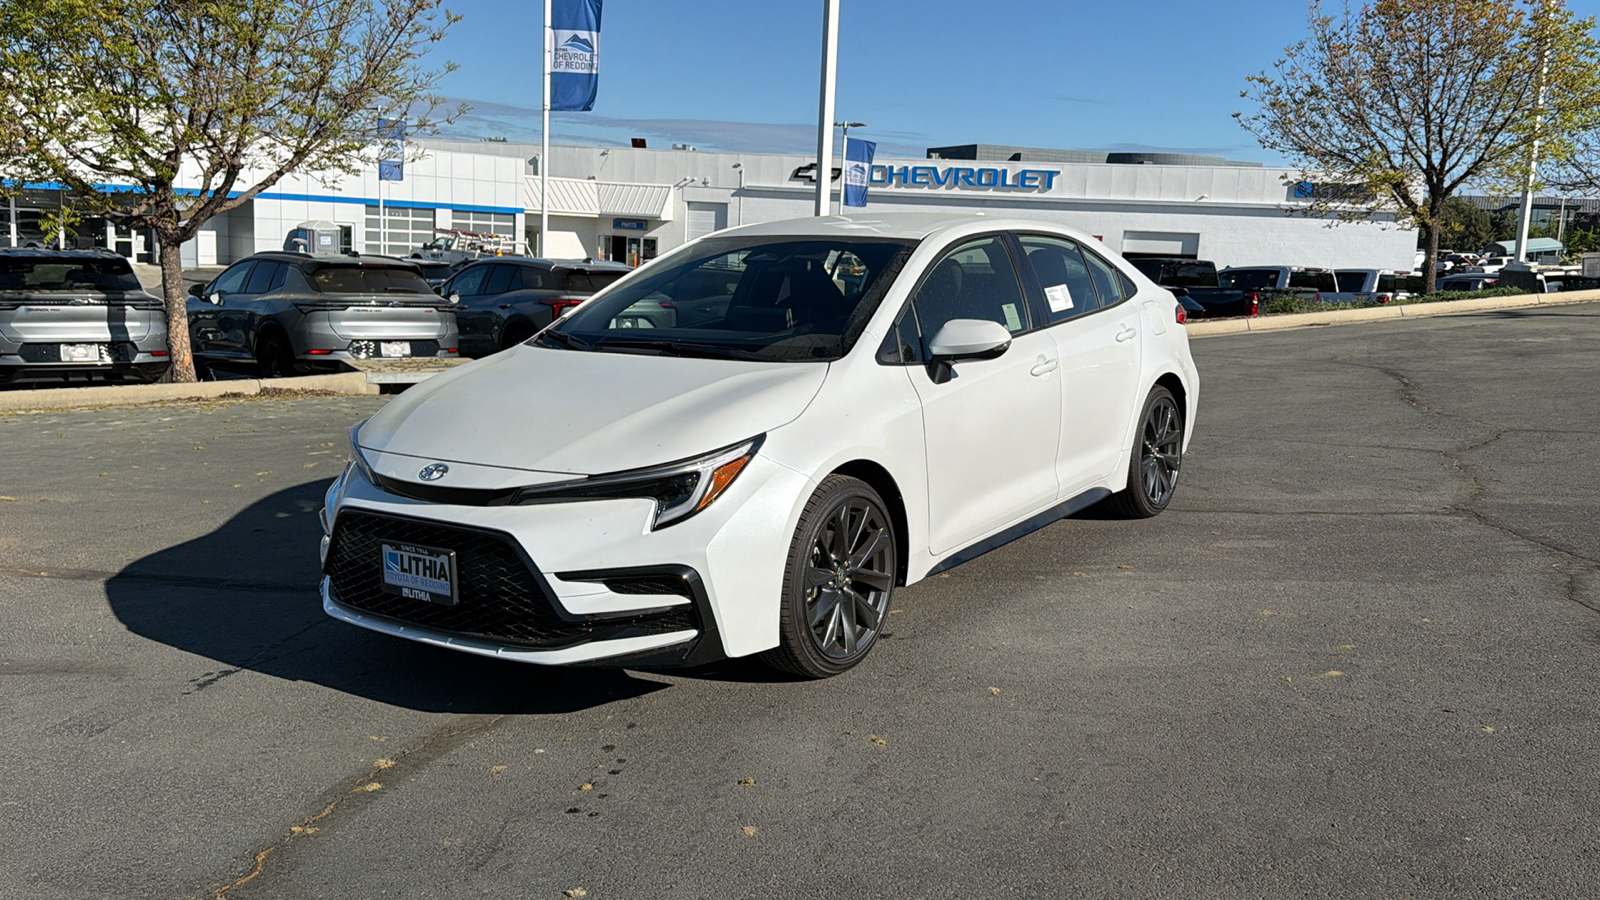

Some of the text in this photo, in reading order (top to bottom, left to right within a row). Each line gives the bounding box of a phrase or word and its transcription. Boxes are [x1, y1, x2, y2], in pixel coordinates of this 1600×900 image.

[554, 52, 598, 62] CHEVROLET
[553, 60, 598, 70] OF REDDING
[869, 164, 1061, 190] CHEVROLET
[400, 544, 416, 553] SINCE
[400, 553, 449, 582] LITHIA
[386, 571, 450, 592] TOYOTA OF REDDING
[408, 588, 431, 602] LITHIA
